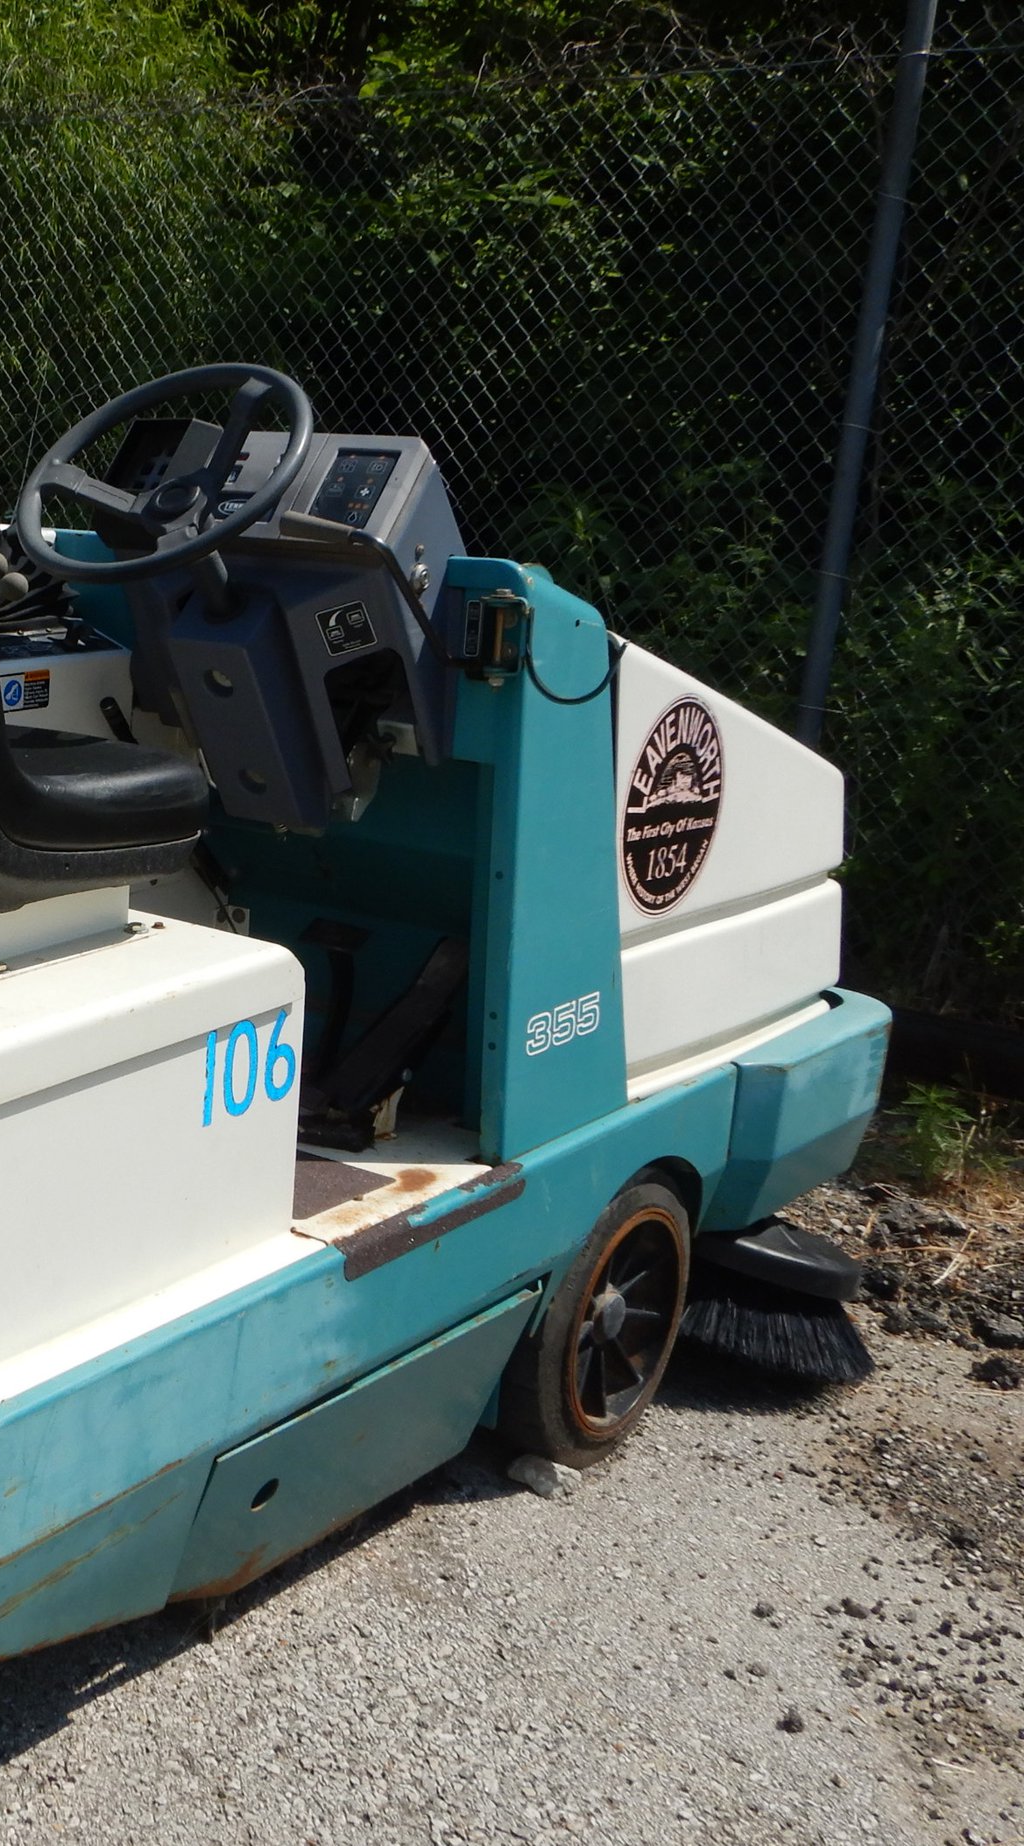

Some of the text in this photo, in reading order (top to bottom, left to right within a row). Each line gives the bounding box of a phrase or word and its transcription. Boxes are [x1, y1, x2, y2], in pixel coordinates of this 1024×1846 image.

[627, 706, 721, 814] LEAVENWORTH
[626, 817, 714, 842] The First City Of Kansas
[645, 842, 688, 881] 1854
[526, 991, 600, 1056] 355
[202, 1008, 296, 1127] 106
